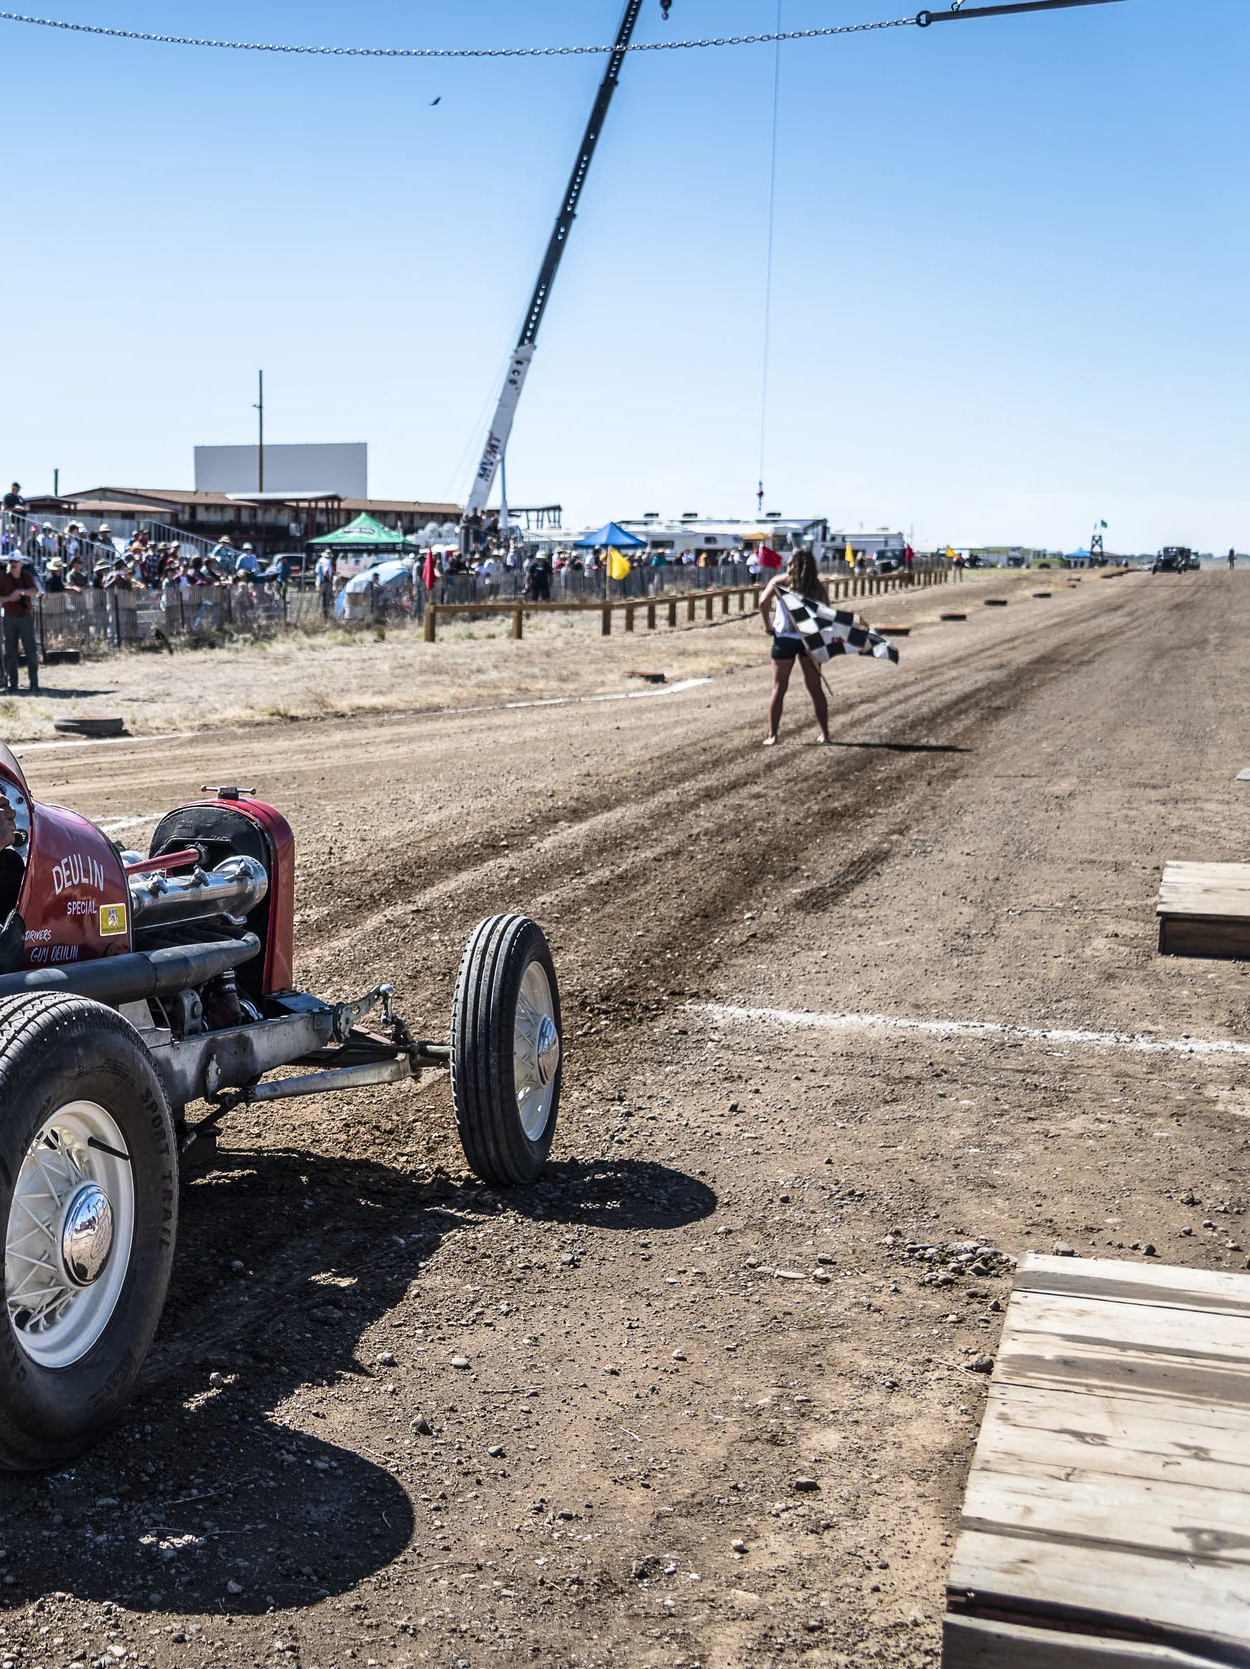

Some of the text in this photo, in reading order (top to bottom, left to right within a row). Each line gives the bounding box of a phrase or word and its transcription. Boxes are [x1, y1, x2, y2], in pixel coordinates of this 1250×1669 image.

[52, 854, 104, 896] DEULIN
[67, 900, 97, 915] SPECIAL
[25, 929, 52, 942] DRIVERS
[30, 944, 79, 963] GUY DEULIN
[141, 1087, 170, 1156] SPORT
